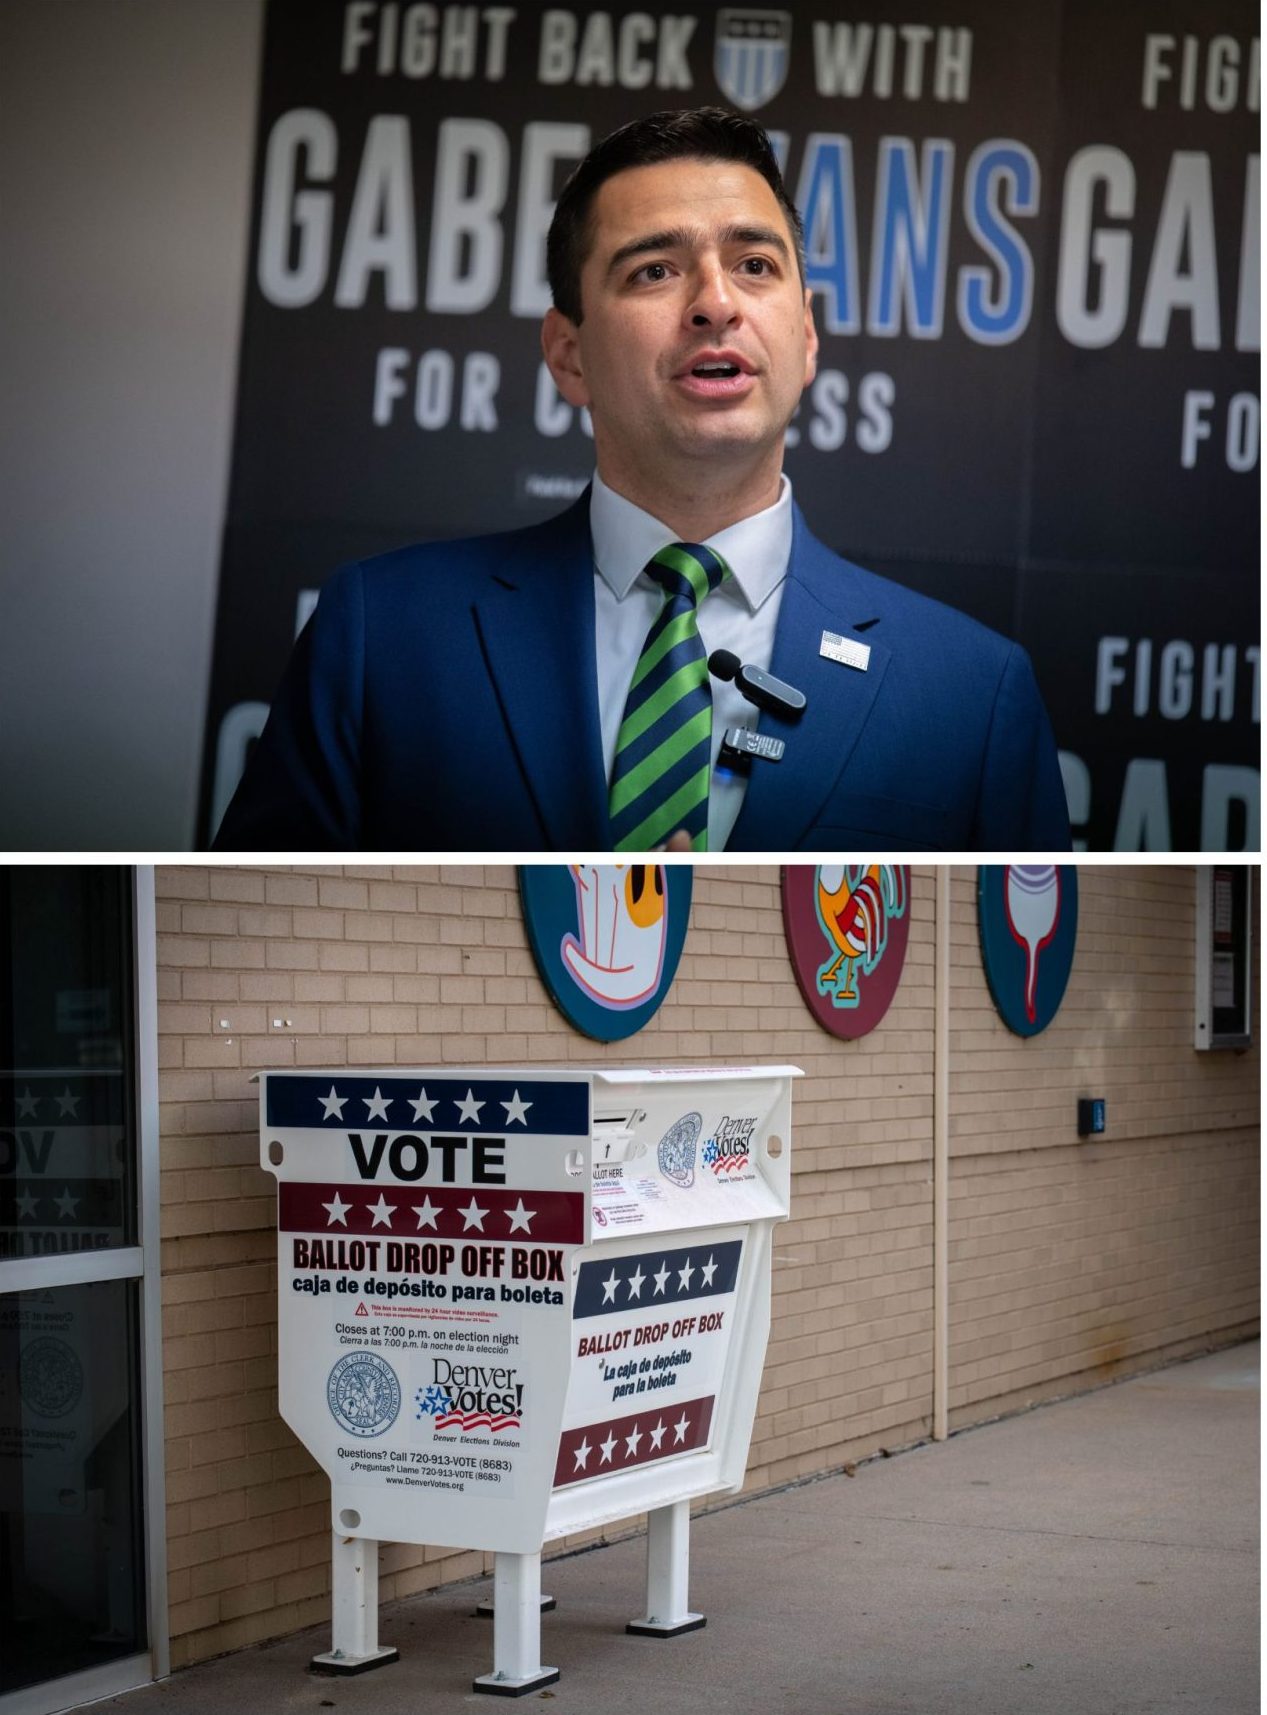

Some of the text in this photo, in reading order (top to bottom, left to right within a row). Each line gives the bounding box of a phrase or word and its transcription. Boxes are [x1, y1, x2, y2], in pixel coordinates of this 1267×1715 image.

[341, 2, 973, 102] FIGHT BACK WITH
[257, 108, 1041, 345] GABE ANS
[373, 348, 499, 432] FOR
[714, 1116, 757, 1137] Denver
[348, 1134, 506, 1184] VOTE
[293, 1239, 565, 1282] BALLOT DROP OFF BOX
[292, 1275, 564, 1305] caja de depósito para boleta
[335, 1323, 519, 1346] Closes at 7:00 p.m. on election night
[340, 1335, 509, 1354] Cierra a las 7:00 p.m. la noche de la elección
[578, 1312, 724, 1357] BALLOT DROP OFF BOX
[432, 1358, 517, 1389] Denver
[604, 1349, 692, 1381] La caja de depósito
[443, 1384, 524, 1417] Votes!
[612, 1371, 677, 1401] para la boleta
[433, 1434, 520, 1448] Denver Elections Division
[337, 1447, 512, 1472] Questions? Call 720-913-VOTE (8683)
[351, 1462, 501, 1483] ¿Preguntas? Llame 720-913-VOTE (8683)
[386, 1477, 464, 1492] www.DenverVotes.org
